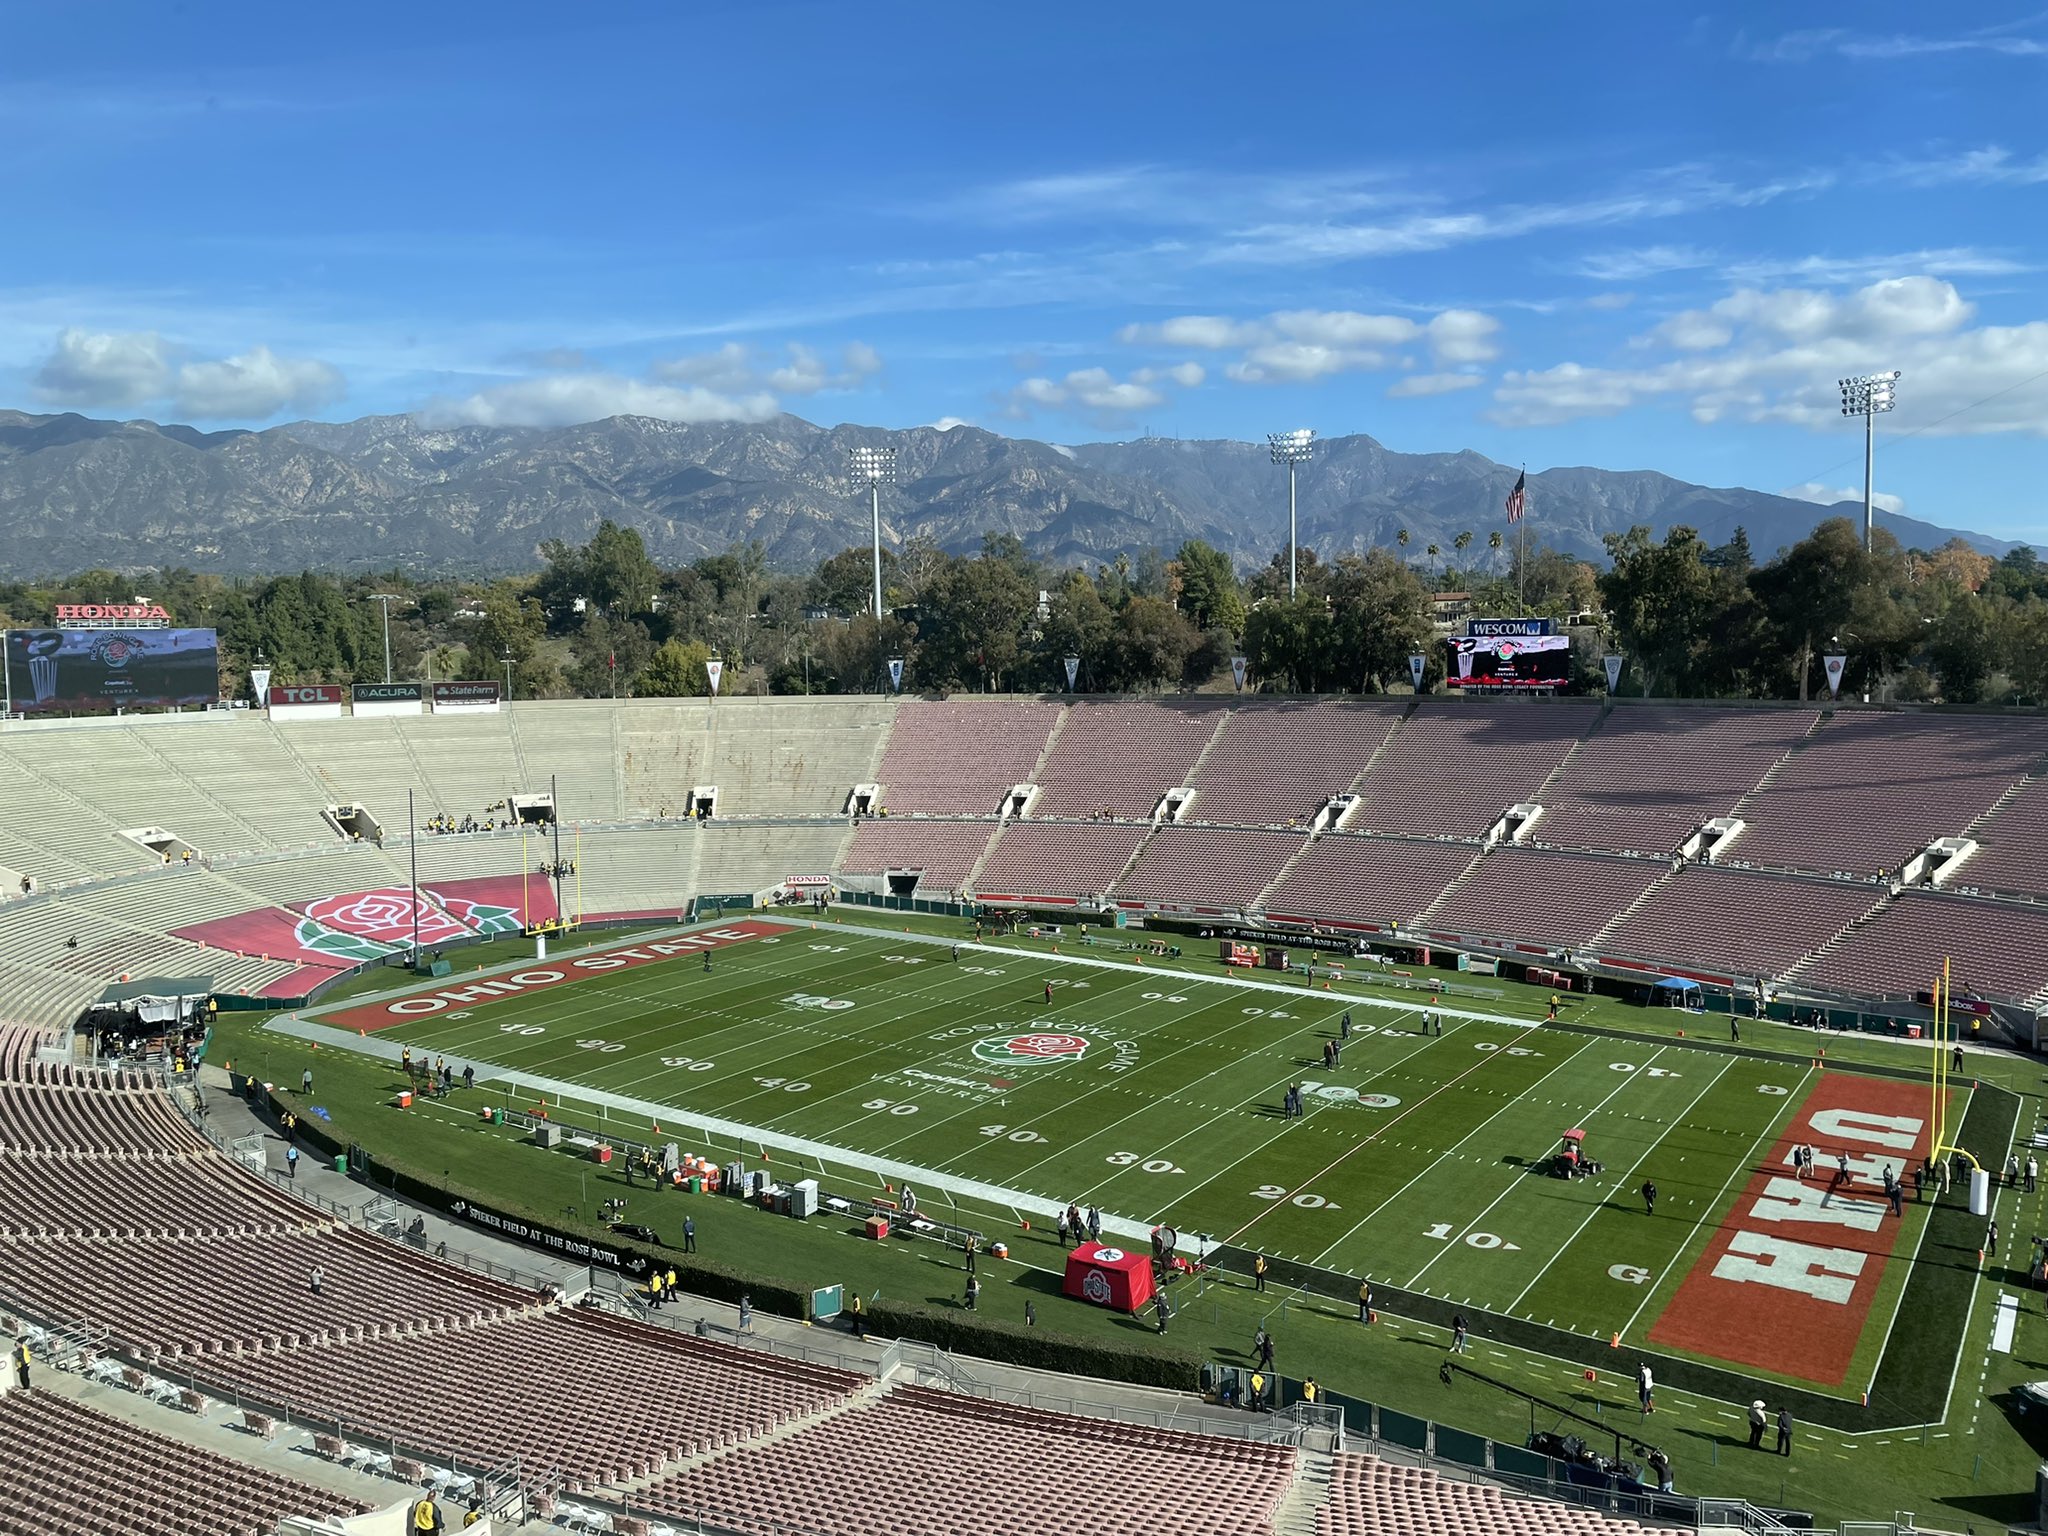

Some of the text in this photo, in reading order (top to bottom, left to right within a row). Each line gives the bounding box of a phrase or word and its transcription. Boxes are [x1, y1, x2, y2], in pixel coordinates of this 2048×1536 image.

[55, 604, 171, 619] HONDA
[102, 631, 128, 640] BOWL
[1474, 623, 1526, 635] WESCOM
[283, 688, 329, 702] TCL
[368, 687, 418, 697] ACURA
[1267, 933, 1287, 941] FIELD
[387, 928, 758, 1014] OHIO STATE
[502, 1023, 546, 1036] 10
[582, 1039, 626, 1053] 20
[928, 1021, 1141, 1073] ROSE BOWL GAME
[667, 1056, 715, 1072] 30
[759, 1077, 811, 1093] 40
[871, 1073, 990, 1102] VENTURE
[861, 1098, 919, 1115] 50
[979, 1124, 1038, 1143] 40
[1105, 1150, 1174, 1174] 30
[1250, 1184, 1327, 1210] 20
[1711, 1108, 1925, 1305] UTAH
[469, 1207, 621, 1266] SPIEKER FIELD AT THE ROSE BOWL
[1422, 1222, 1503, 1250] 10
[1607, 1263, 1651, 1285] G
